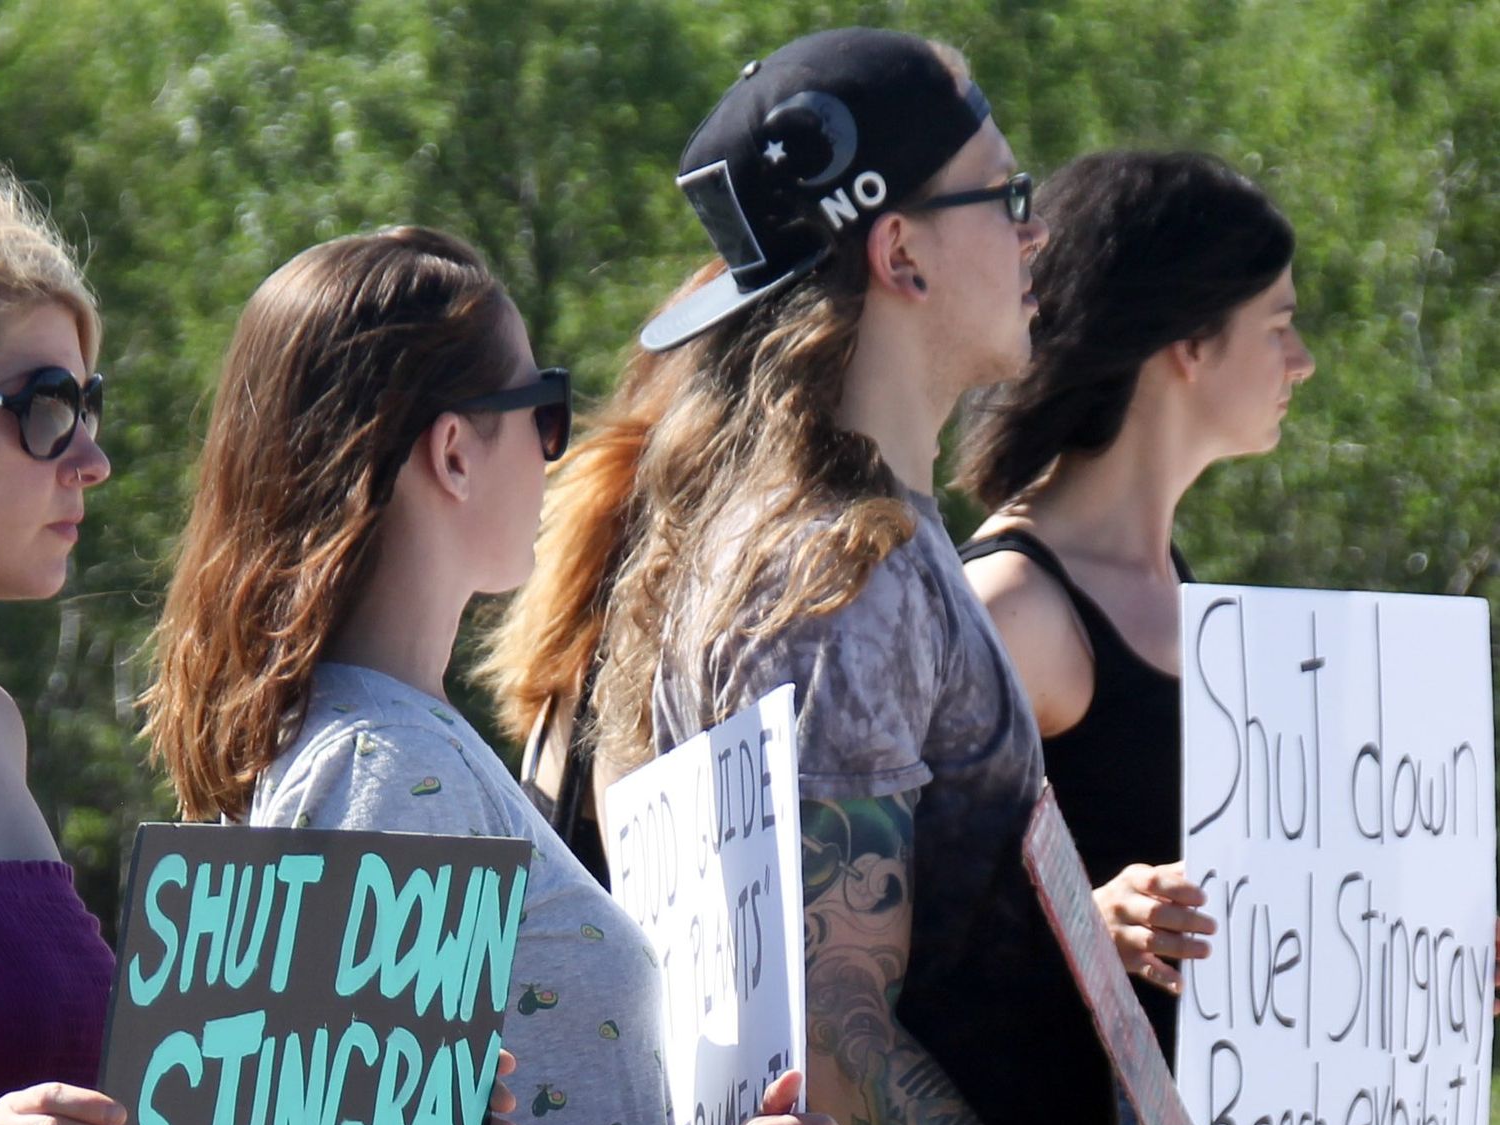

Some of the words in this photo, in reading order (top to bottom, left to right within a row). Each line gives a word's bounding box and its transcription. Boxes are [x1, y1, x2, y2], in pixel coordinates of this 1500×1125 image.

[819, 170, 887, 231] NO
[1188, 594, 1325, 848] Shut
[1351, 602, 1480, 845] down
[129, 853, 323, 1006] SHUT
[335, 853, 527, 1022] DOWN
[619, 790, 678, 927] FOOD
[1328, 870, 1490, 1066] Stingray
